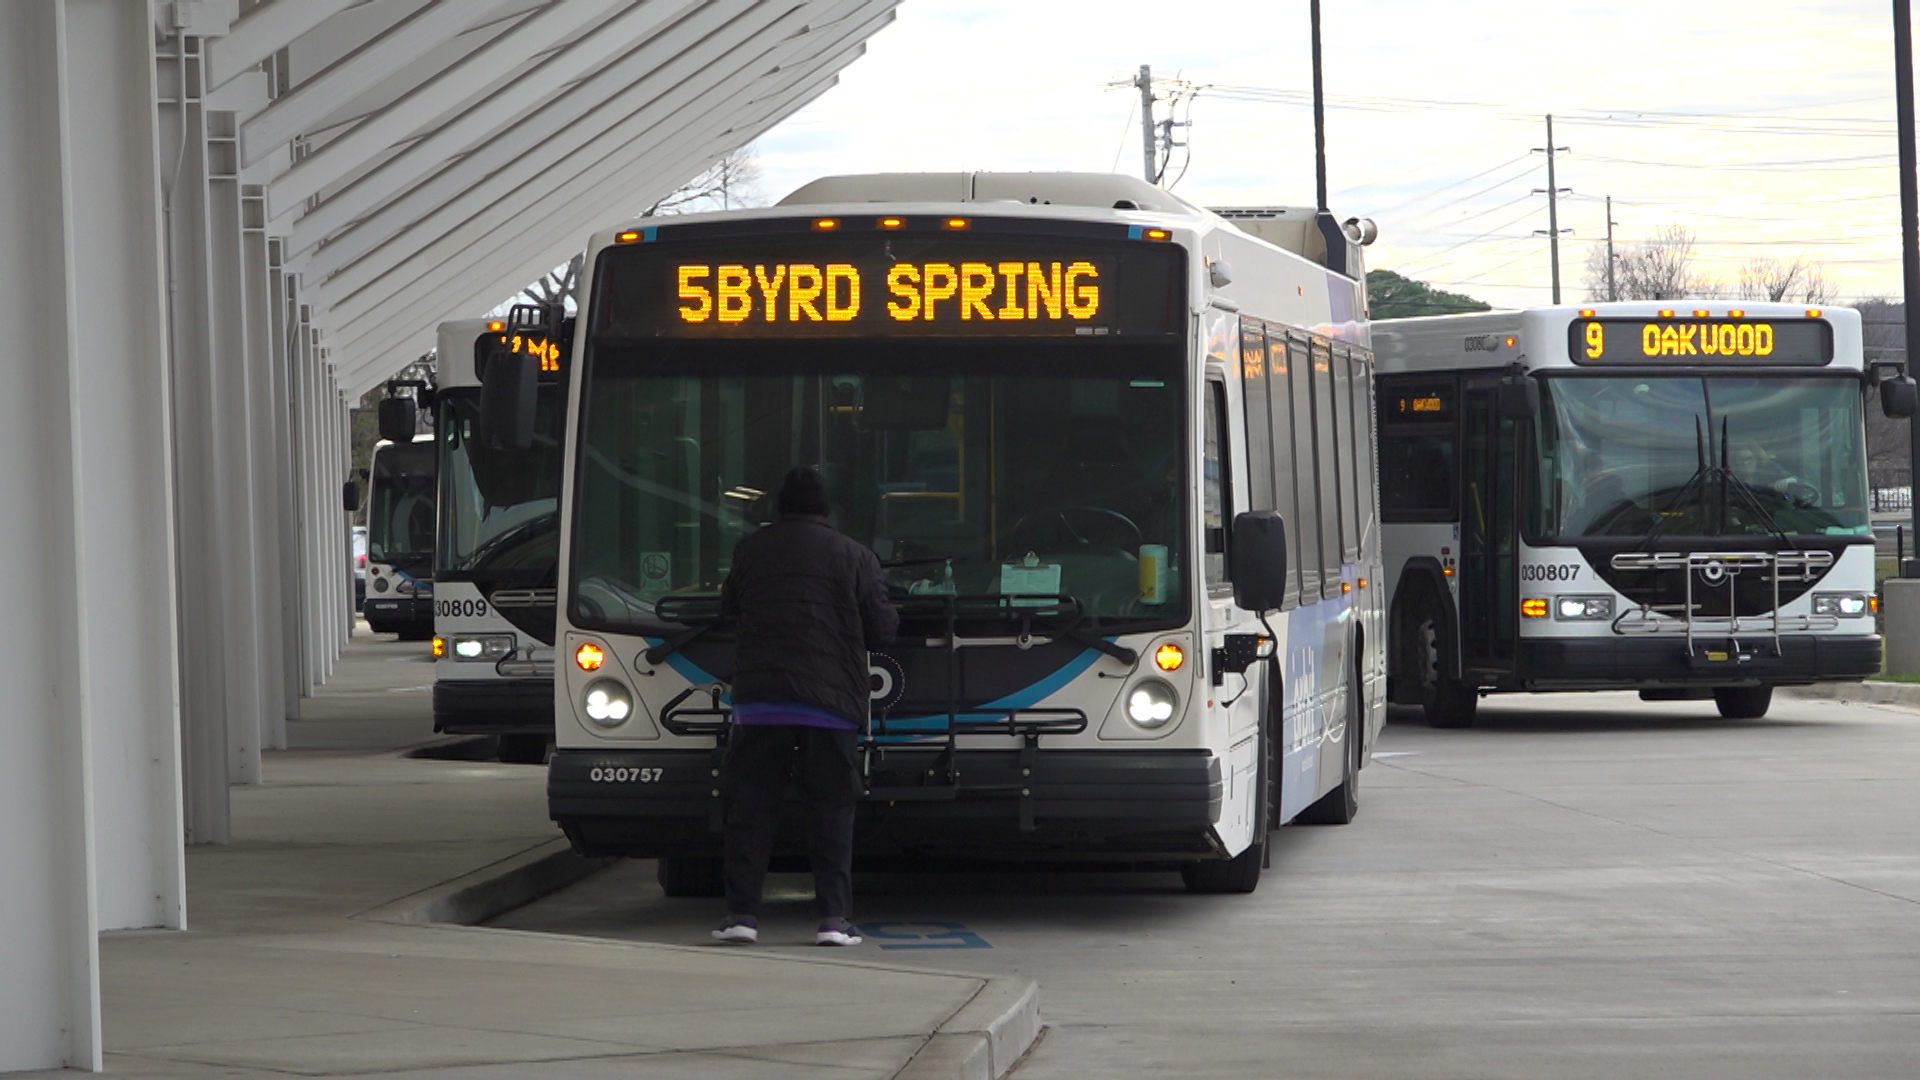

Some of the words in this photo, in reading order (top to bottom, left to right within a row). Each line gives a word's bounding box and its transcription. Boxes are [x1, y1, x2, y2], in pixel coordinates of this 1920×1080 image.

[888, 262, 1098, 320] SPRING
[1586, 323, 1603, 358] 9
[1643, 324, 1772, 355] OAKWOOD
[1522, 564, 1581, 581] 030807
[590, 767, 664, 783] 030757
